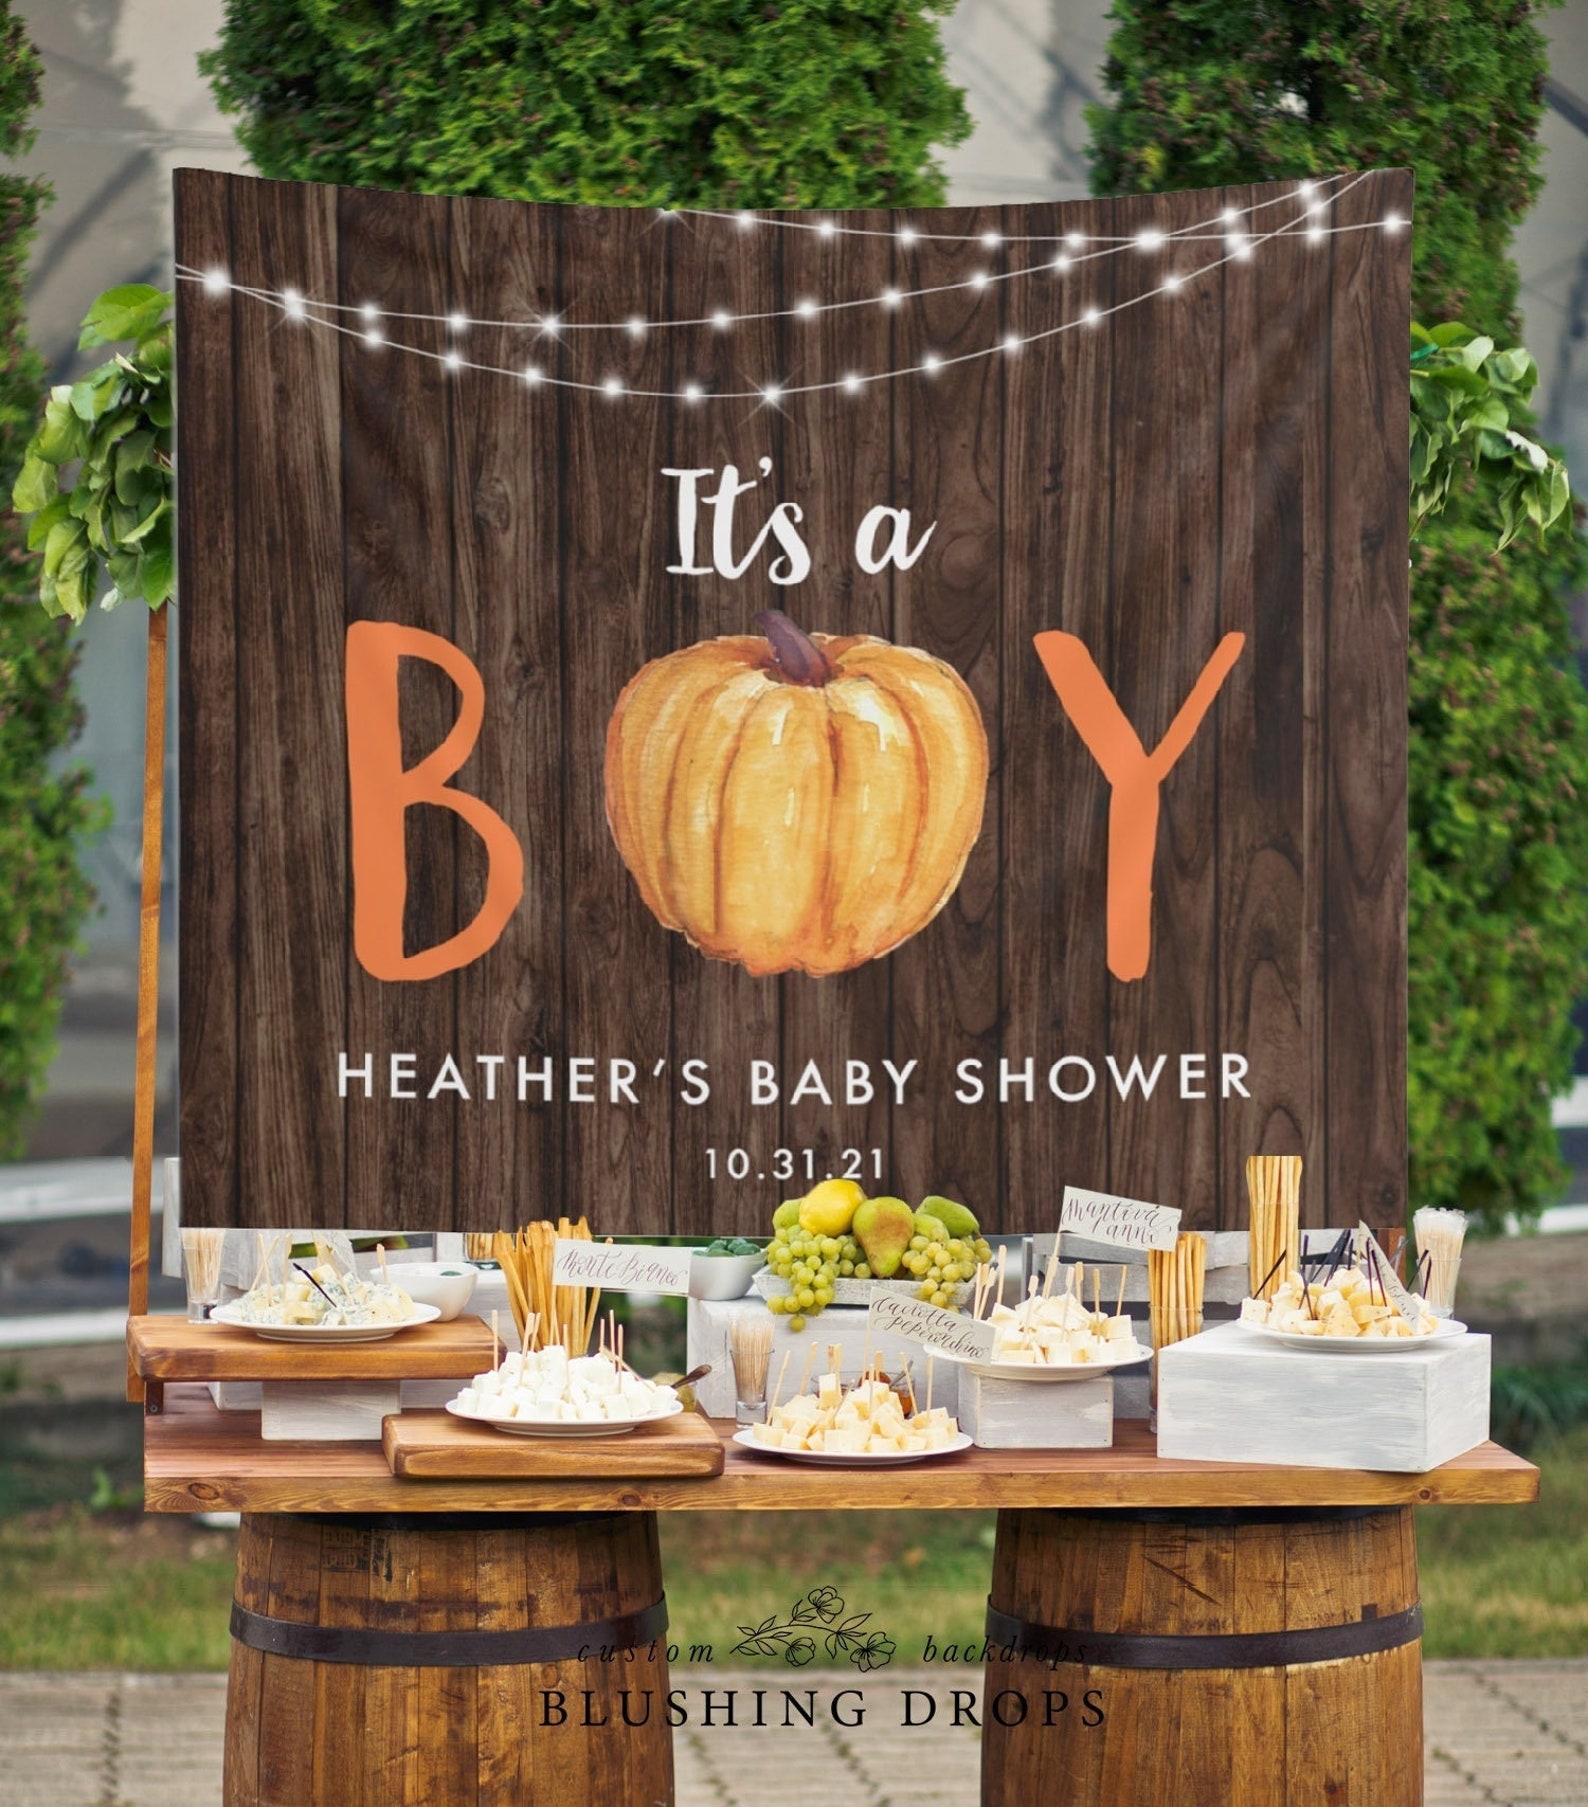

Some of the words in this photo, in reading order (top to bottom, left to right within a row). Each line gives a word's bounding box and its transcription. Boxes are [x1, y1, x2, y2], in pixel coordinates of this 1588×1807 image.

[661, 456, 811, 586] It's
[855, 505, 938, 575] a
[338, 1052, 710, 1105] HEATHER'S
[751, 1059, 918, 1105] BABY
[955, 1053, 1251, 1104] SHOWER
[706, 1148, 881, 1180] 10.31.21
